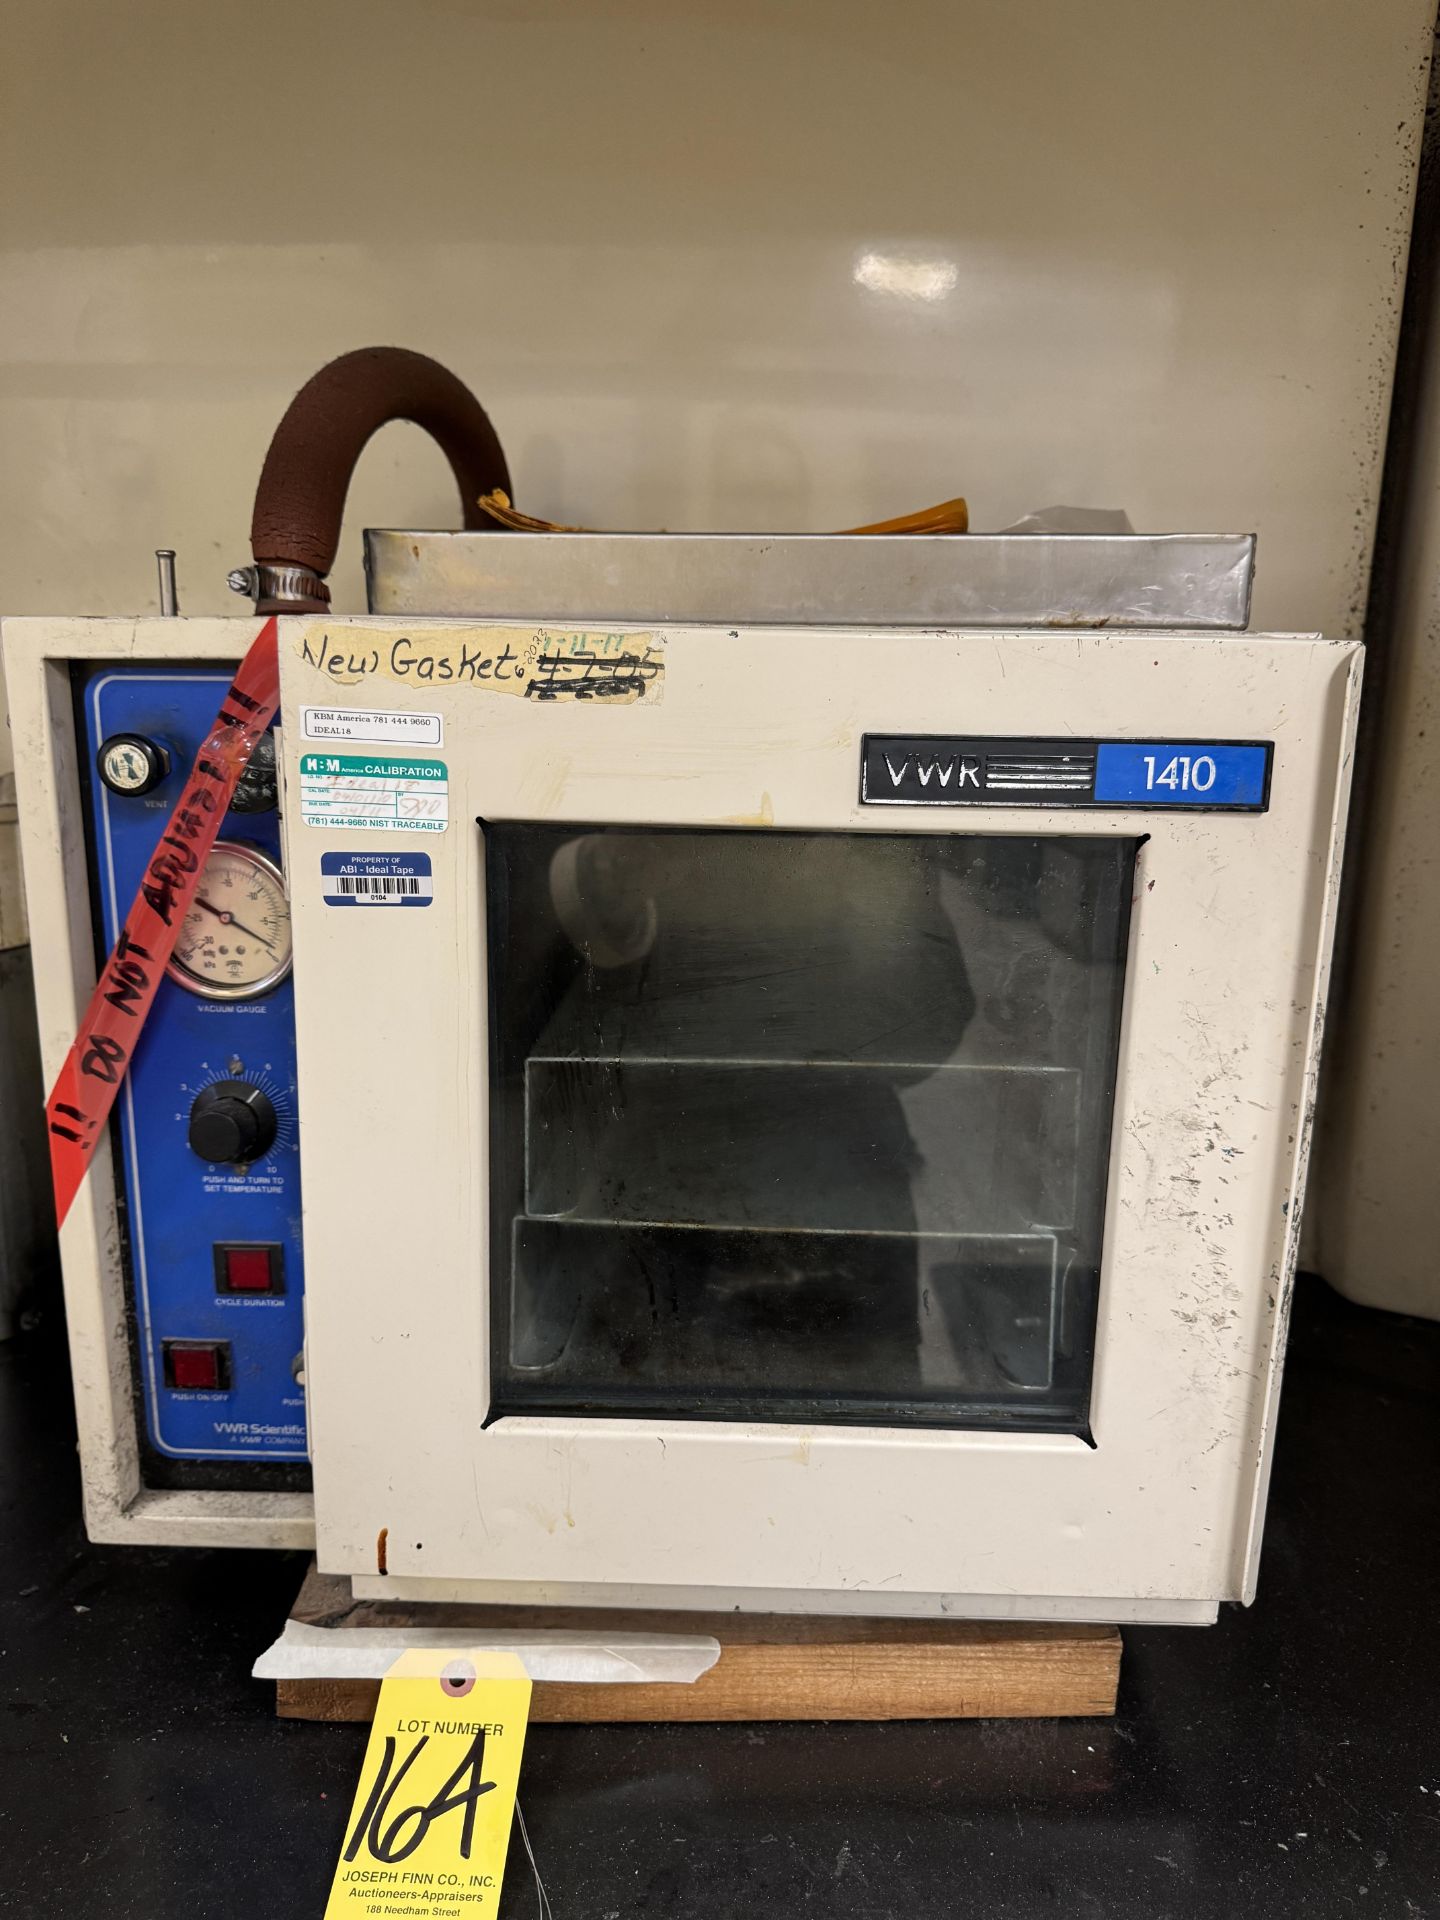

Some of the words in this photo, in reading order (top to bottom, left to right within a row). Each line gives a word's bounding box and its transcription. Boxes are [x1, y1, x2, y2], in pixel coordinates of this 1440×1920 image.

[391, 638, 518, 681] Gasket
[313, 712, 335, 721] KBM
[336, 714, 371, 723] America
[373, 716, 388, 724] 781
[391, 717, 408, 725] 444
[410, 718, 431, 726] 9660
[314, 726, 352, 735] IDEAL18
[364, 765, 442, 777] CALIBRATION
[882, 752, 980, 788] VWR
[1143, 755, 1217, 791] 1410
[308, 817, 328, 826] (781)
[329, 818, 368, 828] 444-9660
[369, 819, 389, 828] NIST
[391, 820, 444, 830] TRACEABLE
[339, 865, 358, 874] ABI
[366, 866, 389, 874] Ideal
[391, 866, 414, 875] Tape
[82, 1035, 126, 1083] DO
[104, 928, 156, 1017] NOT
[197, 1005, 235, 1013] VACUUM
[236, 1005, 268, 1014] GAUGE
[202, 1175, 226, 1184] PUSH
[227, 1175, 246, 1184] AND
[248, 1176, 270, 1184] TURN
[272, 1176, 284, 1185] TO
[204, 1184, 221, 1193] SET
[223, 1185, 284, 1194] TEMPERATURE
[214, 1298, 241, 1307] CYCLE
[243, 1299, 286, 1307] DURATION
[172, 1393, 195, 1401] PUSH
[213, 1422, 248, 1434] VWR
[249, 1423, 306, 1436] Scientific
[397, 1719, 430, 1733] LOT
[434, 1721, 504, 1736] NUMBER
[343, 1728, 497, 1863] 16A
[342, 1871, 398, 1884] JOSEPH
[401, 1872, 434, 1885] FINN
[437, 1874, 465, 1888] CO.,
[469, 1875, 496, 1888] INC.
[349, 1888, 483, 1903] Auctioneers-Appraisers
[366, 1905, 382, 1914] 188
[384, 1905, 430, 1916] Needham
[431, 1907, 461, 1917] Street
